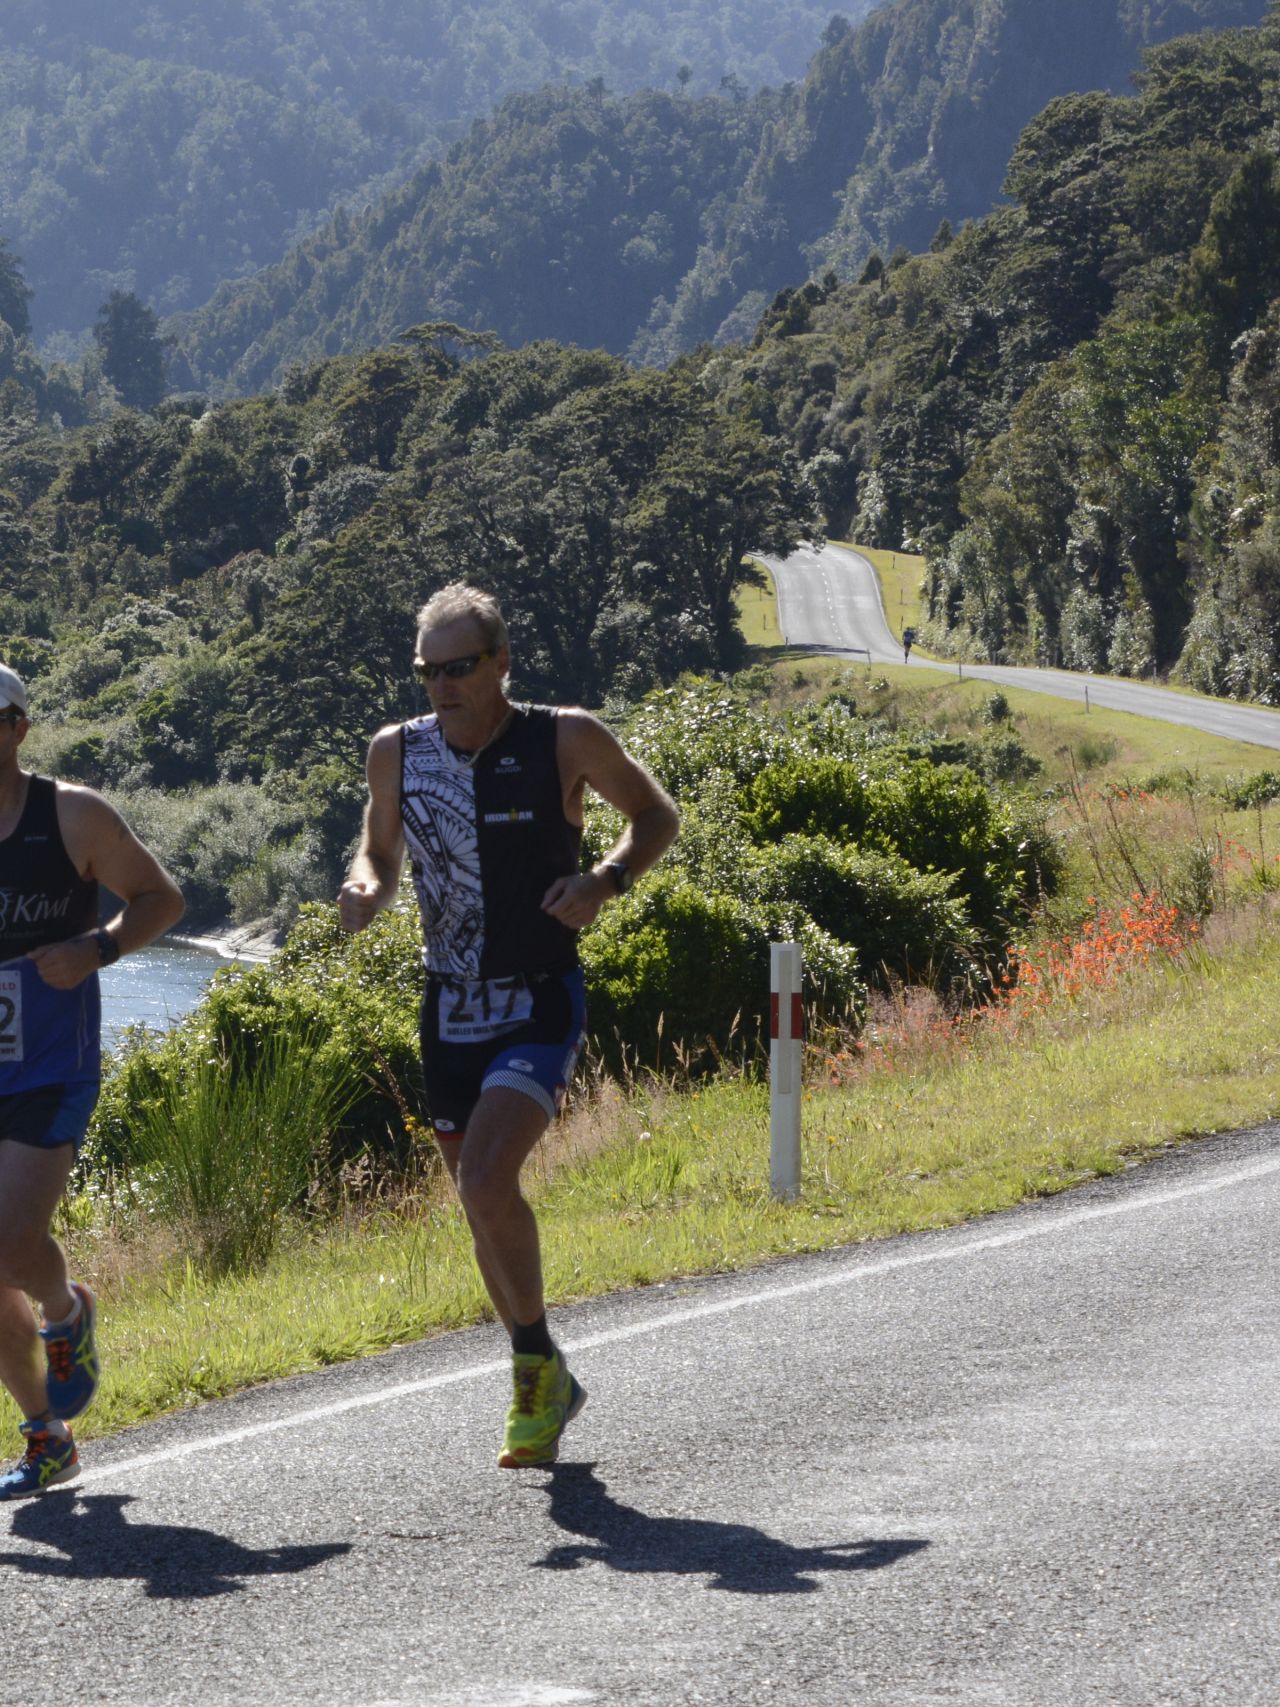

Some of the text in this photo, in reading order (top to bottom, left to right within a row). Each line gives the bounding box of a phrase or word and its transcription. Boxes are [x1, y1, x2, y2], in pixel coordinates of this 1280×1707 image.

[484, 808, 534, 823] IRONMAN
[11, 889, 72, 923] Kiwi
[446, 975, 526, 1023] 217
